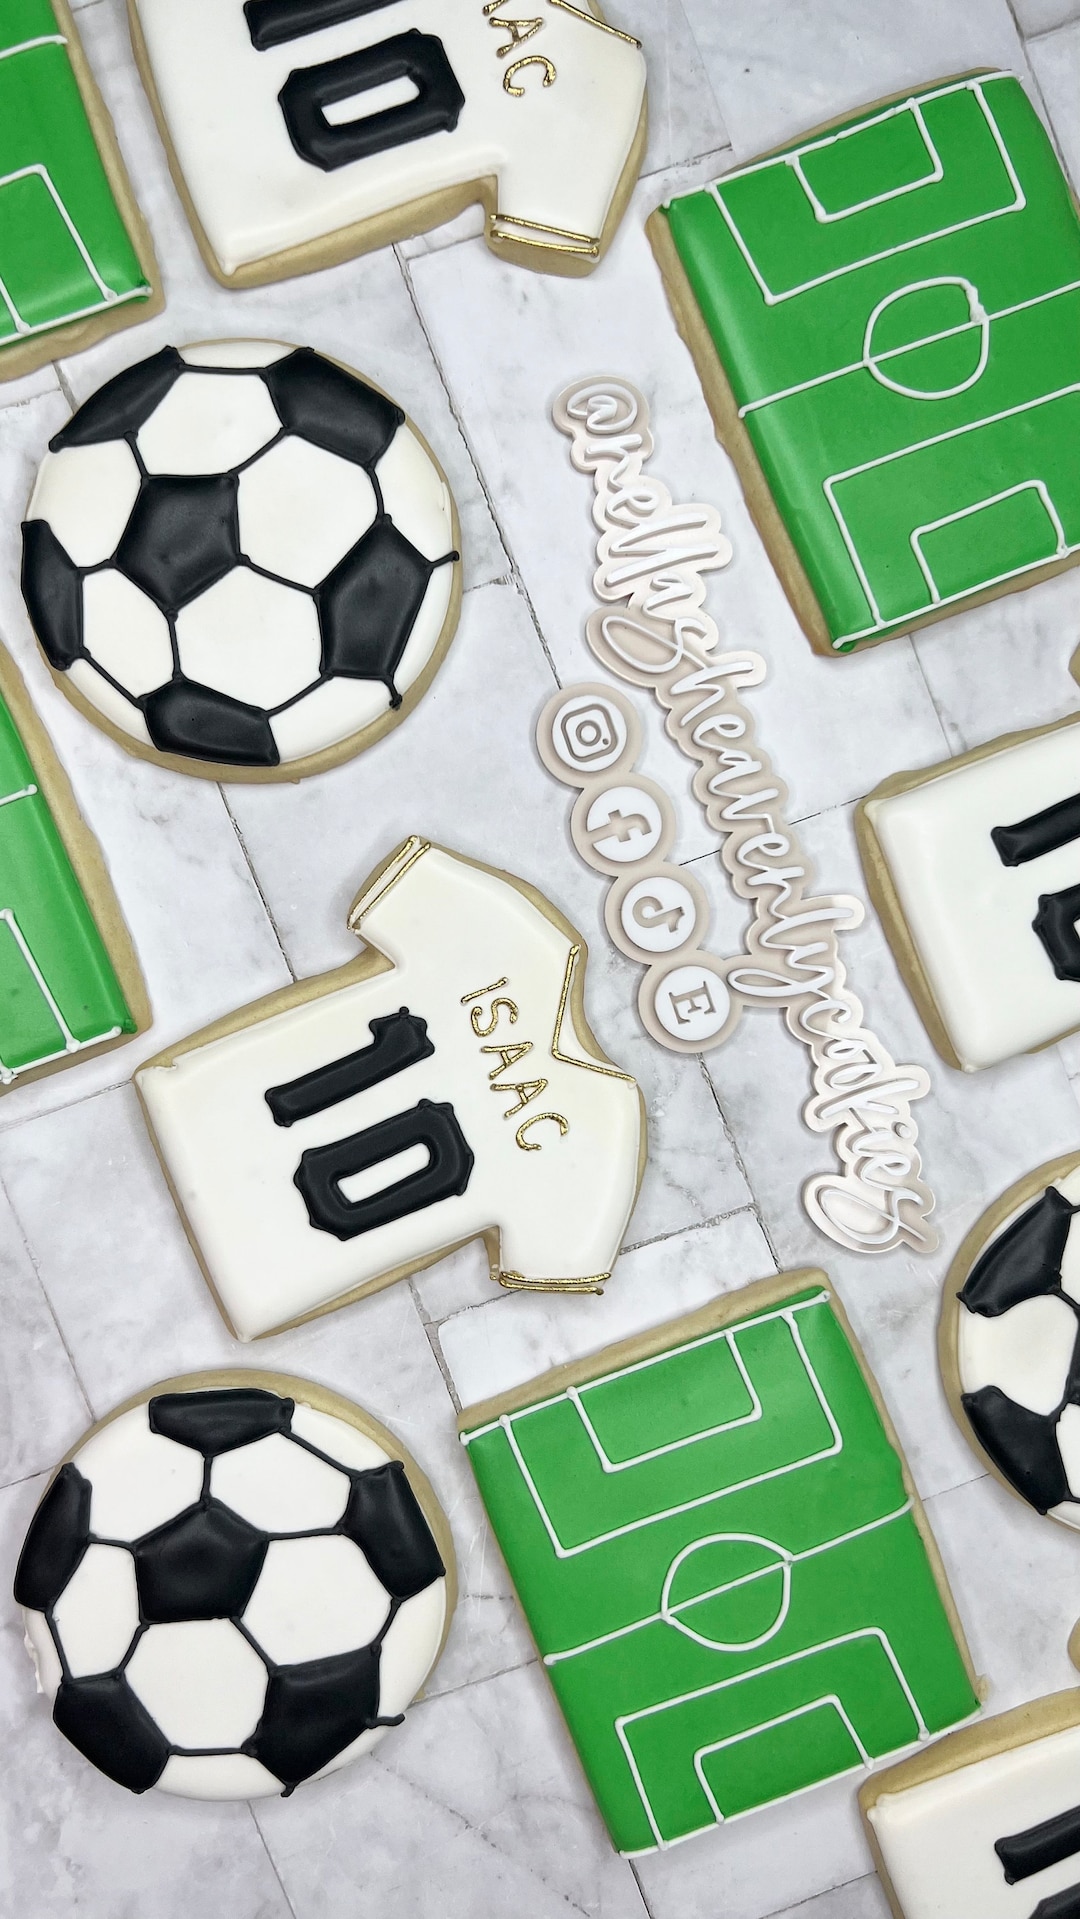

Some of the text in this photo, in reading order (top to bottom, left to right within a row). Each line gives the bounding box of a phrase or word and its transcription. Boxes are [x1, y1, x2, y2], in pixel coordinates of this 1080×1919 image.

[566, 382, 928, 1244] @nellasheavenlycookies
[264, 1005, 475, 1241] 10
[460, 976, 569, 1151] ISAAC
